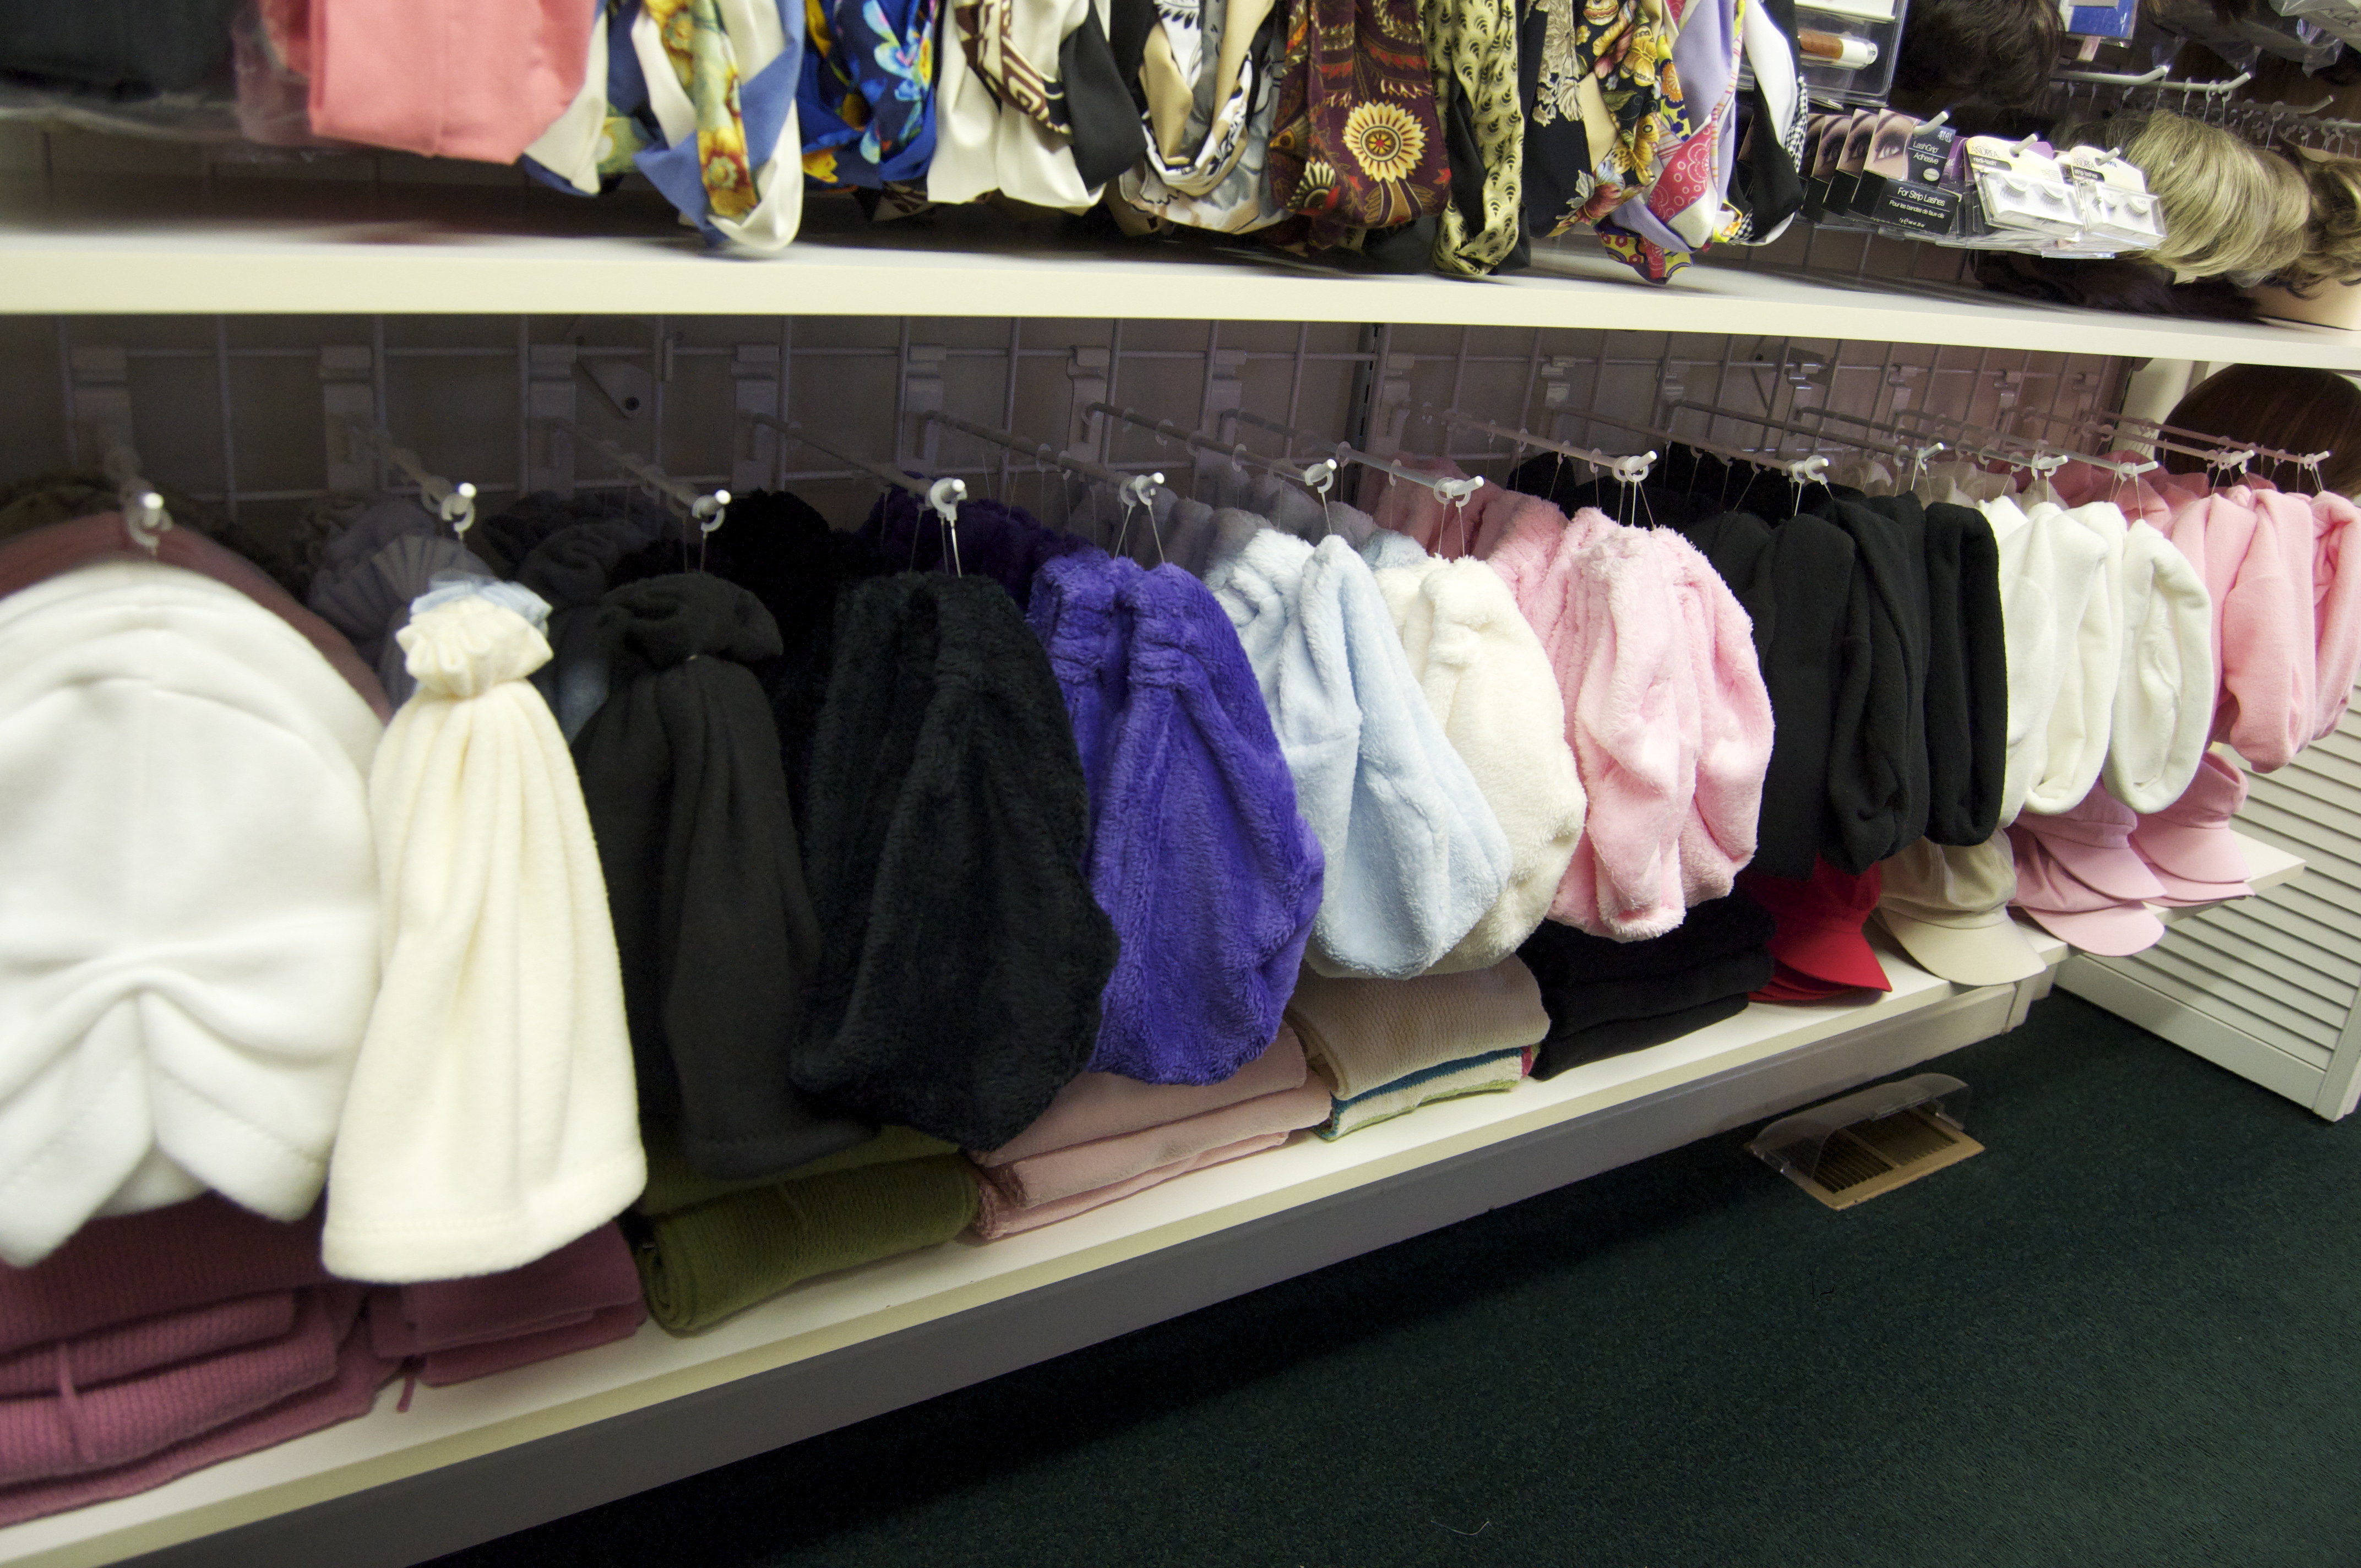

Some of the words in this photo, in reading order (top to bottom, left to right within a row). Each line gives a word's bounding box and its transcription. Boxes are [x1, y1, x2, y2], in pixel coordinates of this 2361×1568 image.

[1913, 152, 1939, 165] Adhesive
[1971, 145, 1999, 159] ANDREA
[1897, 187, 1910, 197] For
[1909, 190, 1923, 202] Strip
[1924, 194, 1946, 206] Lashes
